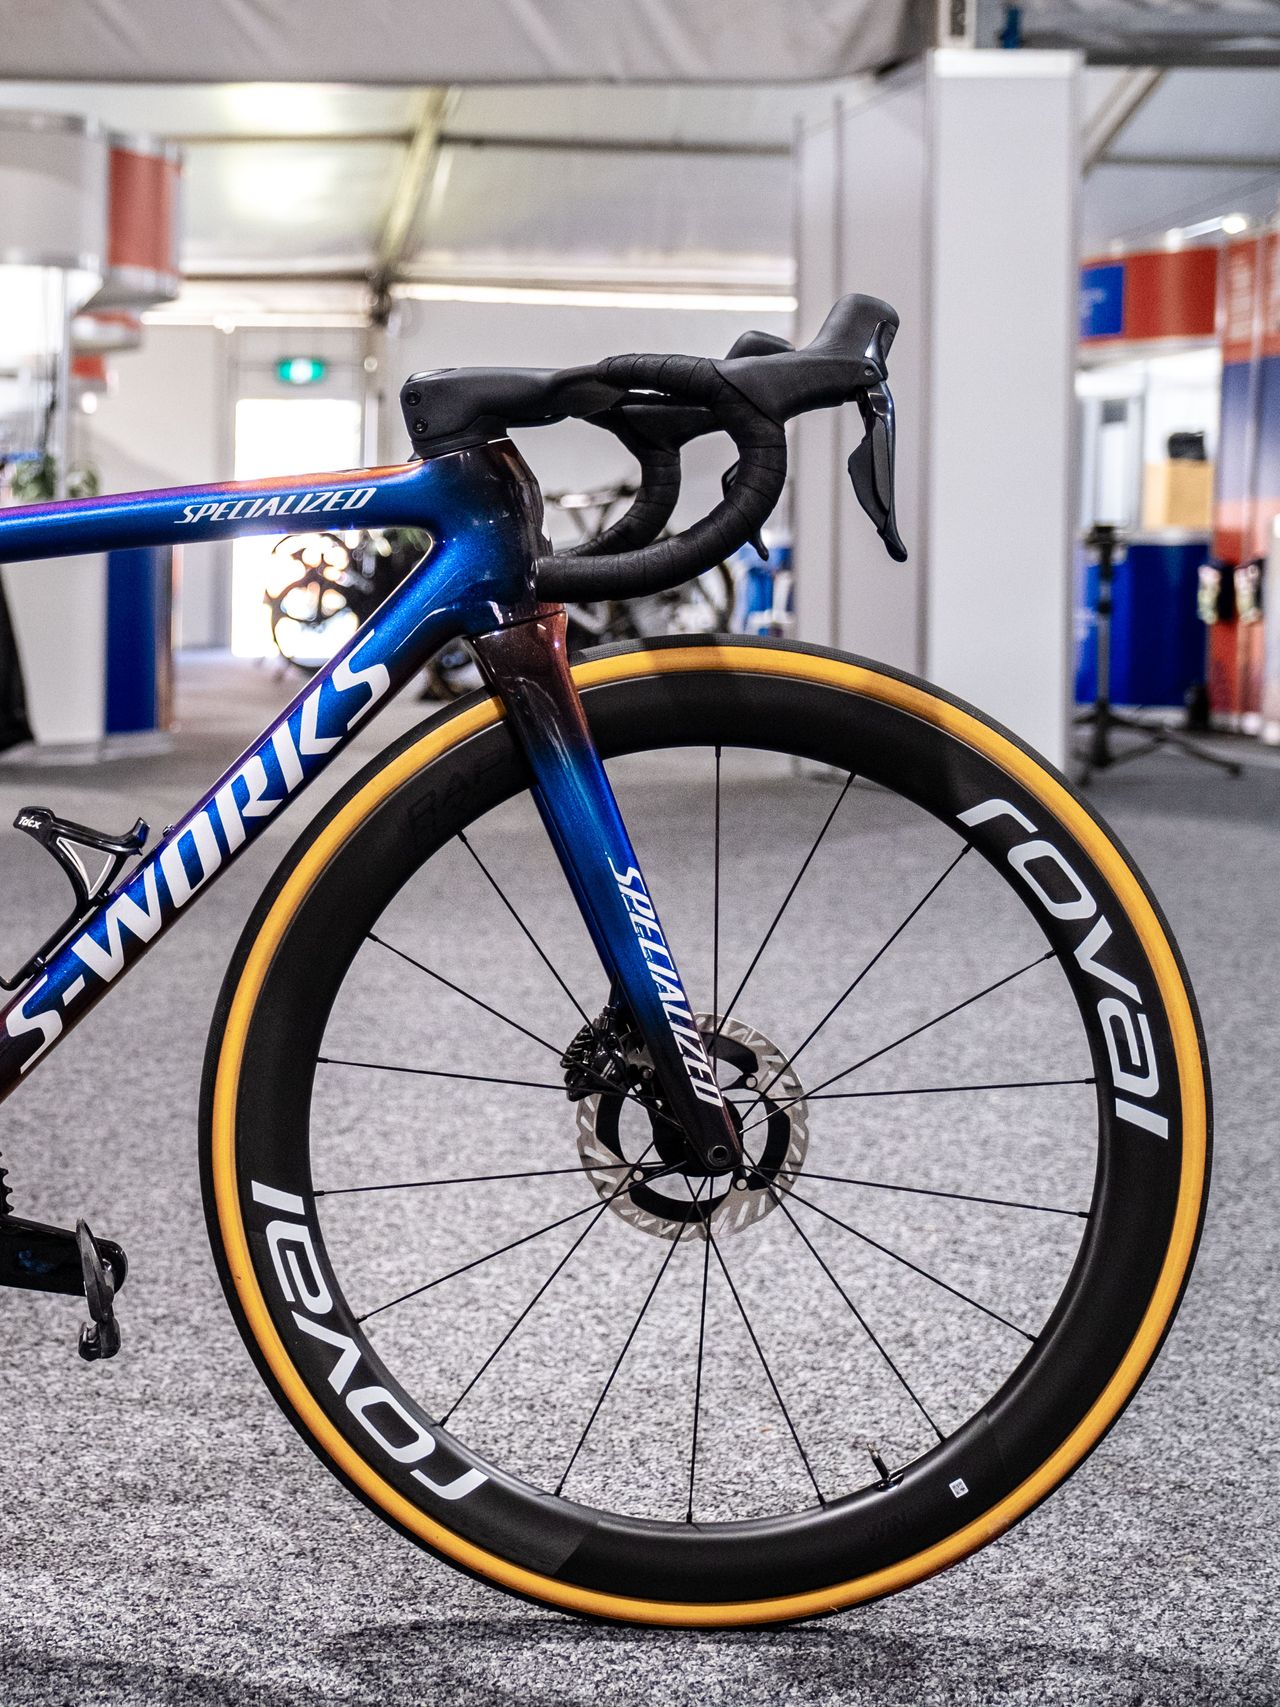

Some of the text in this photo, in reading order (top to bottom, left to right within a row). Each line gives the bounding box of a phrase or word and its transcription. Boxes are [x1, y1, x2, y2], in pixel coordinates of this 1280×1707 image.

[173, 487, 378, 524] SPECIALIZED
[4, 628, 391, 1075] S-WORKS
[18, 815, 42, 830] Tacx
[604, 851, 724, 1108] SPECIALIZED
